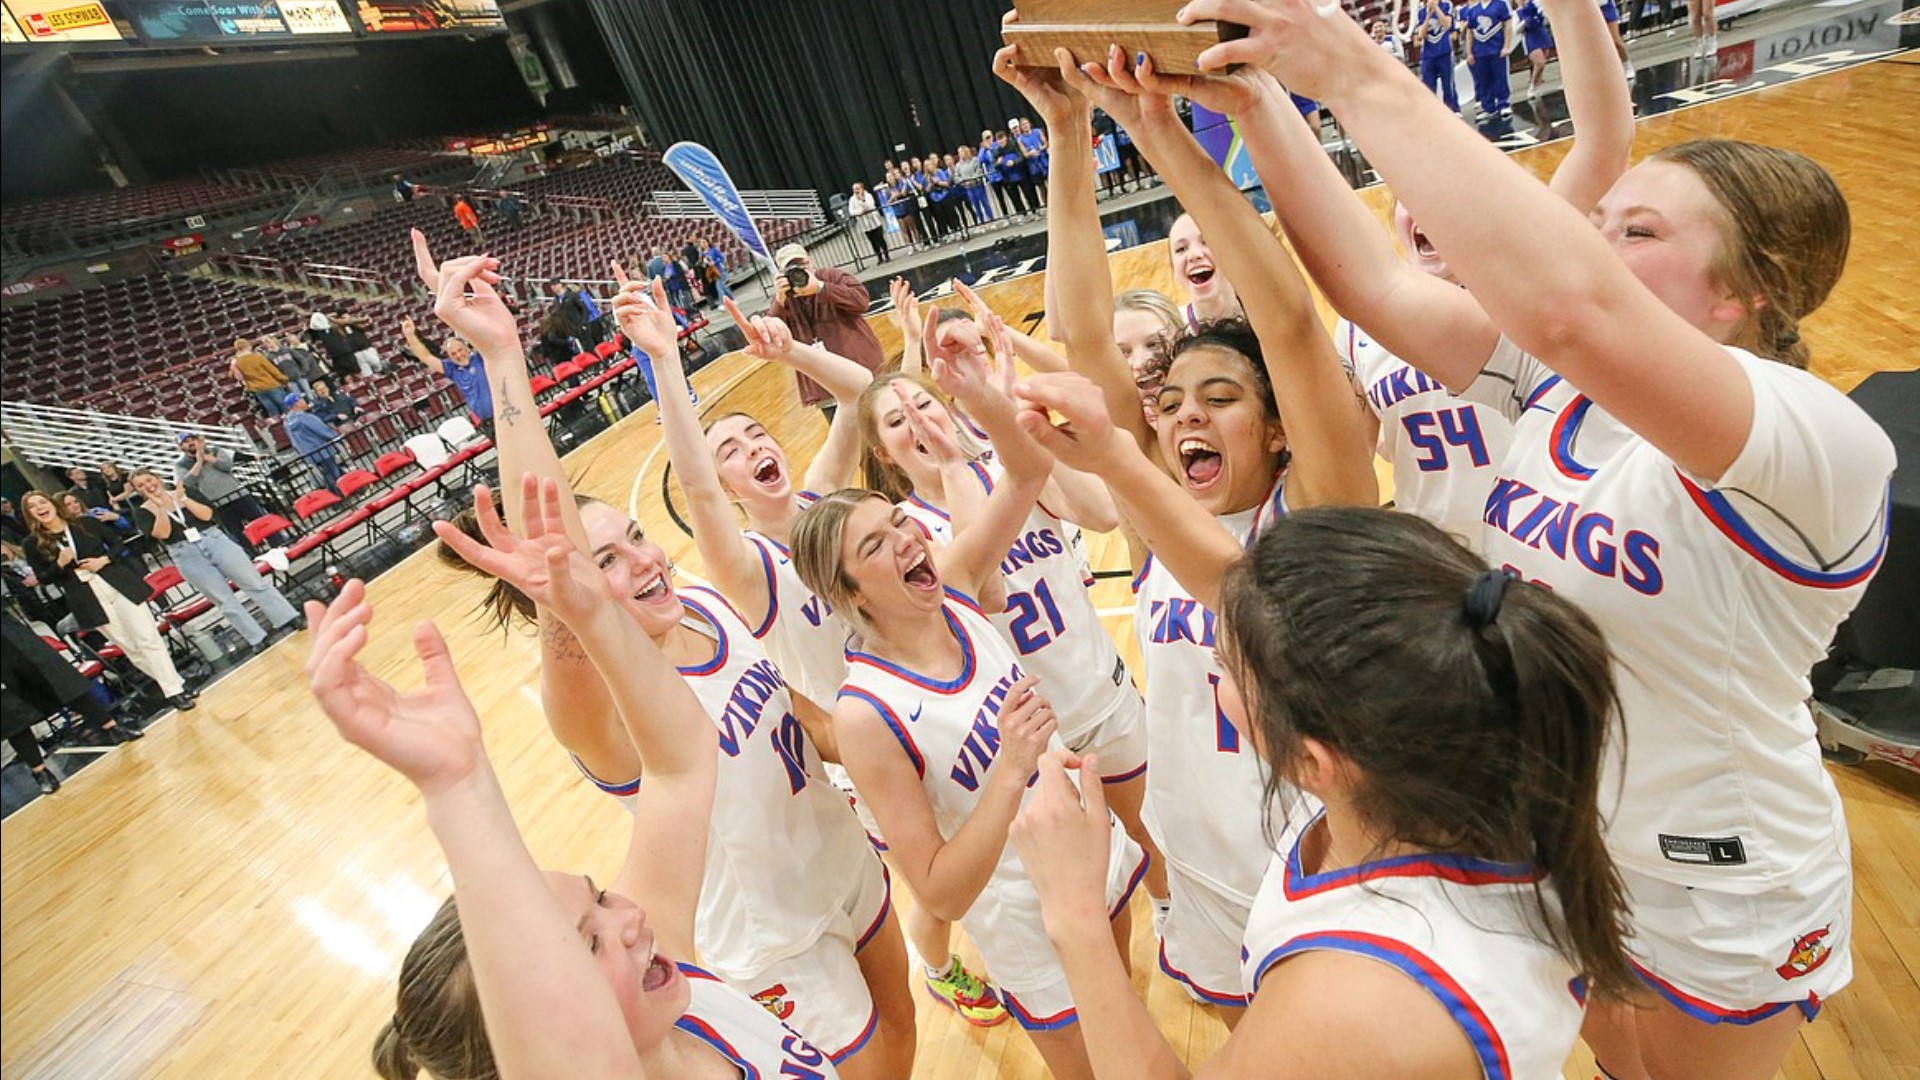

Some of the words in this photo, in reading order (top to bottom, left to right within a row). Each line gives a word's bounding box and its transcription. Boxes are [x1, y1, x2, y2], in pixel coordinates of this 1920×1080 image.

[48, 14, 65, 27] LES
[63, 7, 103, 24] SCHWAB
[1401, 404, 1491, 472] 54
[1002, 577, 1066, 656] 21
[771, 711, 811, 797] 10
[1719, 846, 1733, 859] L
